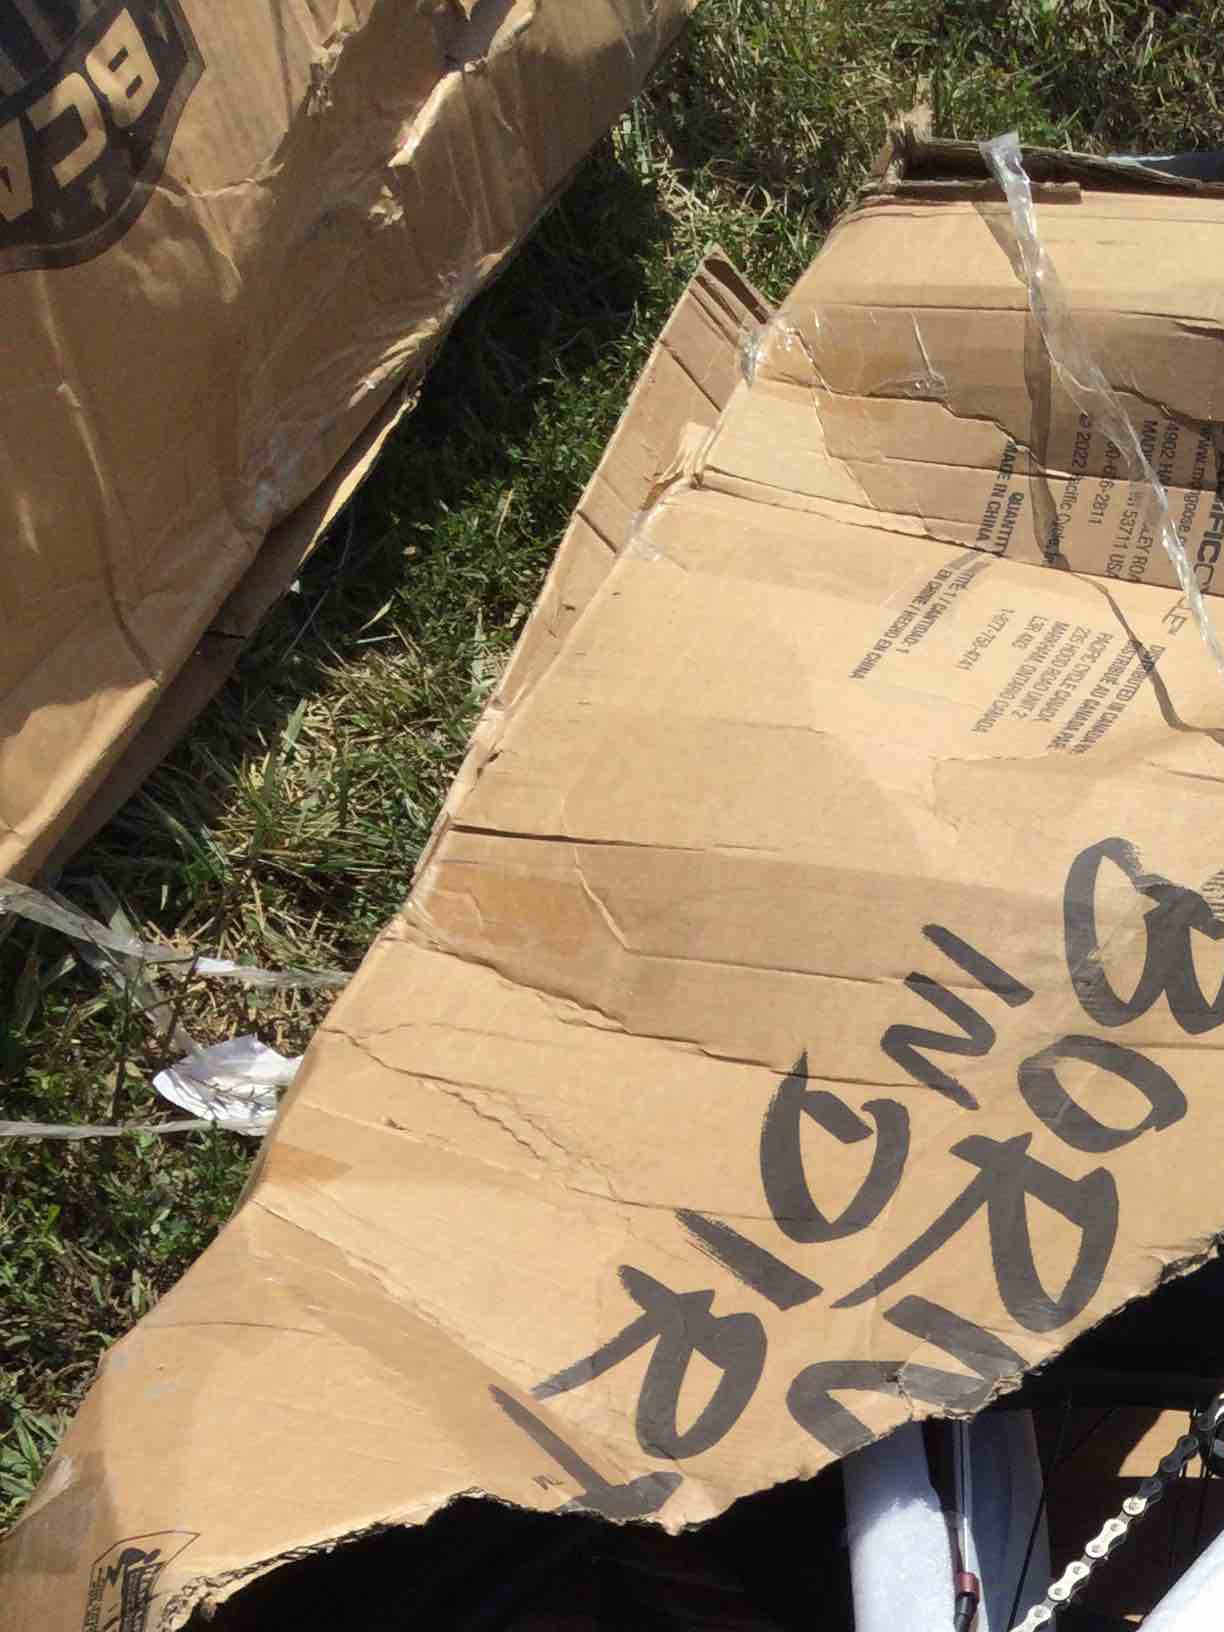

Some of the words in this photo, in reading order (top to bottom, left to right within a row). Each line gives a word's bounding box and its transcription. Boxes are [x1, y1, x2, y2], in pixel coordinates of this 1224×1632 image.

[997, 440, 1018, 480] MADE
[1072, 431, 1091, 468] 2022
[993, 483, 1007, 499] IN
[975, 500, 1001, 541] CHINA
[1117, 511, 1138, 550] 53711
[848, 651, 882, 680] CHINA
[971, 699, 1010, 734] CANADA
[1034, 688, 1071, 722] CANADA
[1084, 711, 1119, 743] CANADA
[881, 922, 1035, 1110] IN
